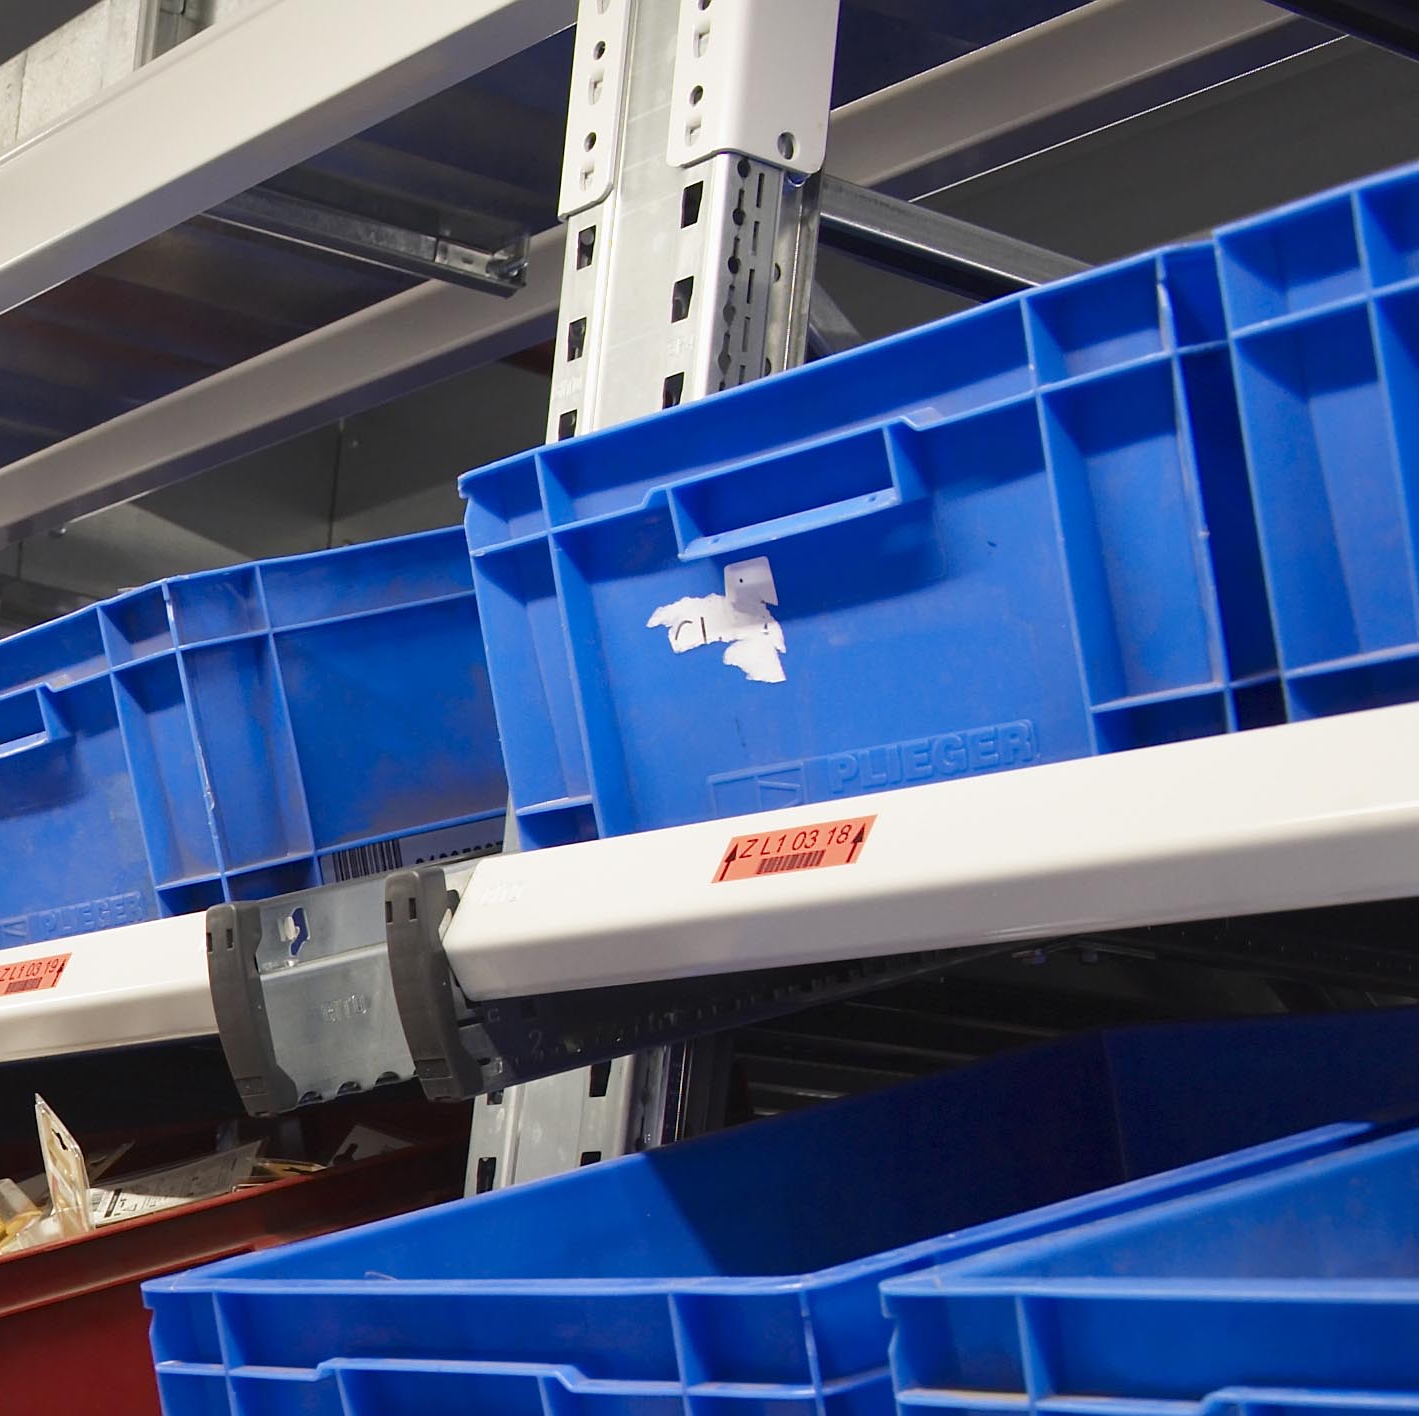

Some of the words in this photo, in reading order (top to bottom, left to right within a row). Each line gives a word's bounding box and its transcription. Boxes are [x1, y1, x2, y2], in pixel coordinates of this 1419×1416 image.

[827, 720, 1039, 795] PLIEGER
[791, 829, 820, 851] 03
[826, 824, 853, 845] 18
[43, 891, 144, 936] PLIEGER
[25, 961, 43, 977] 03
[43, 958, 59, 975] 19
